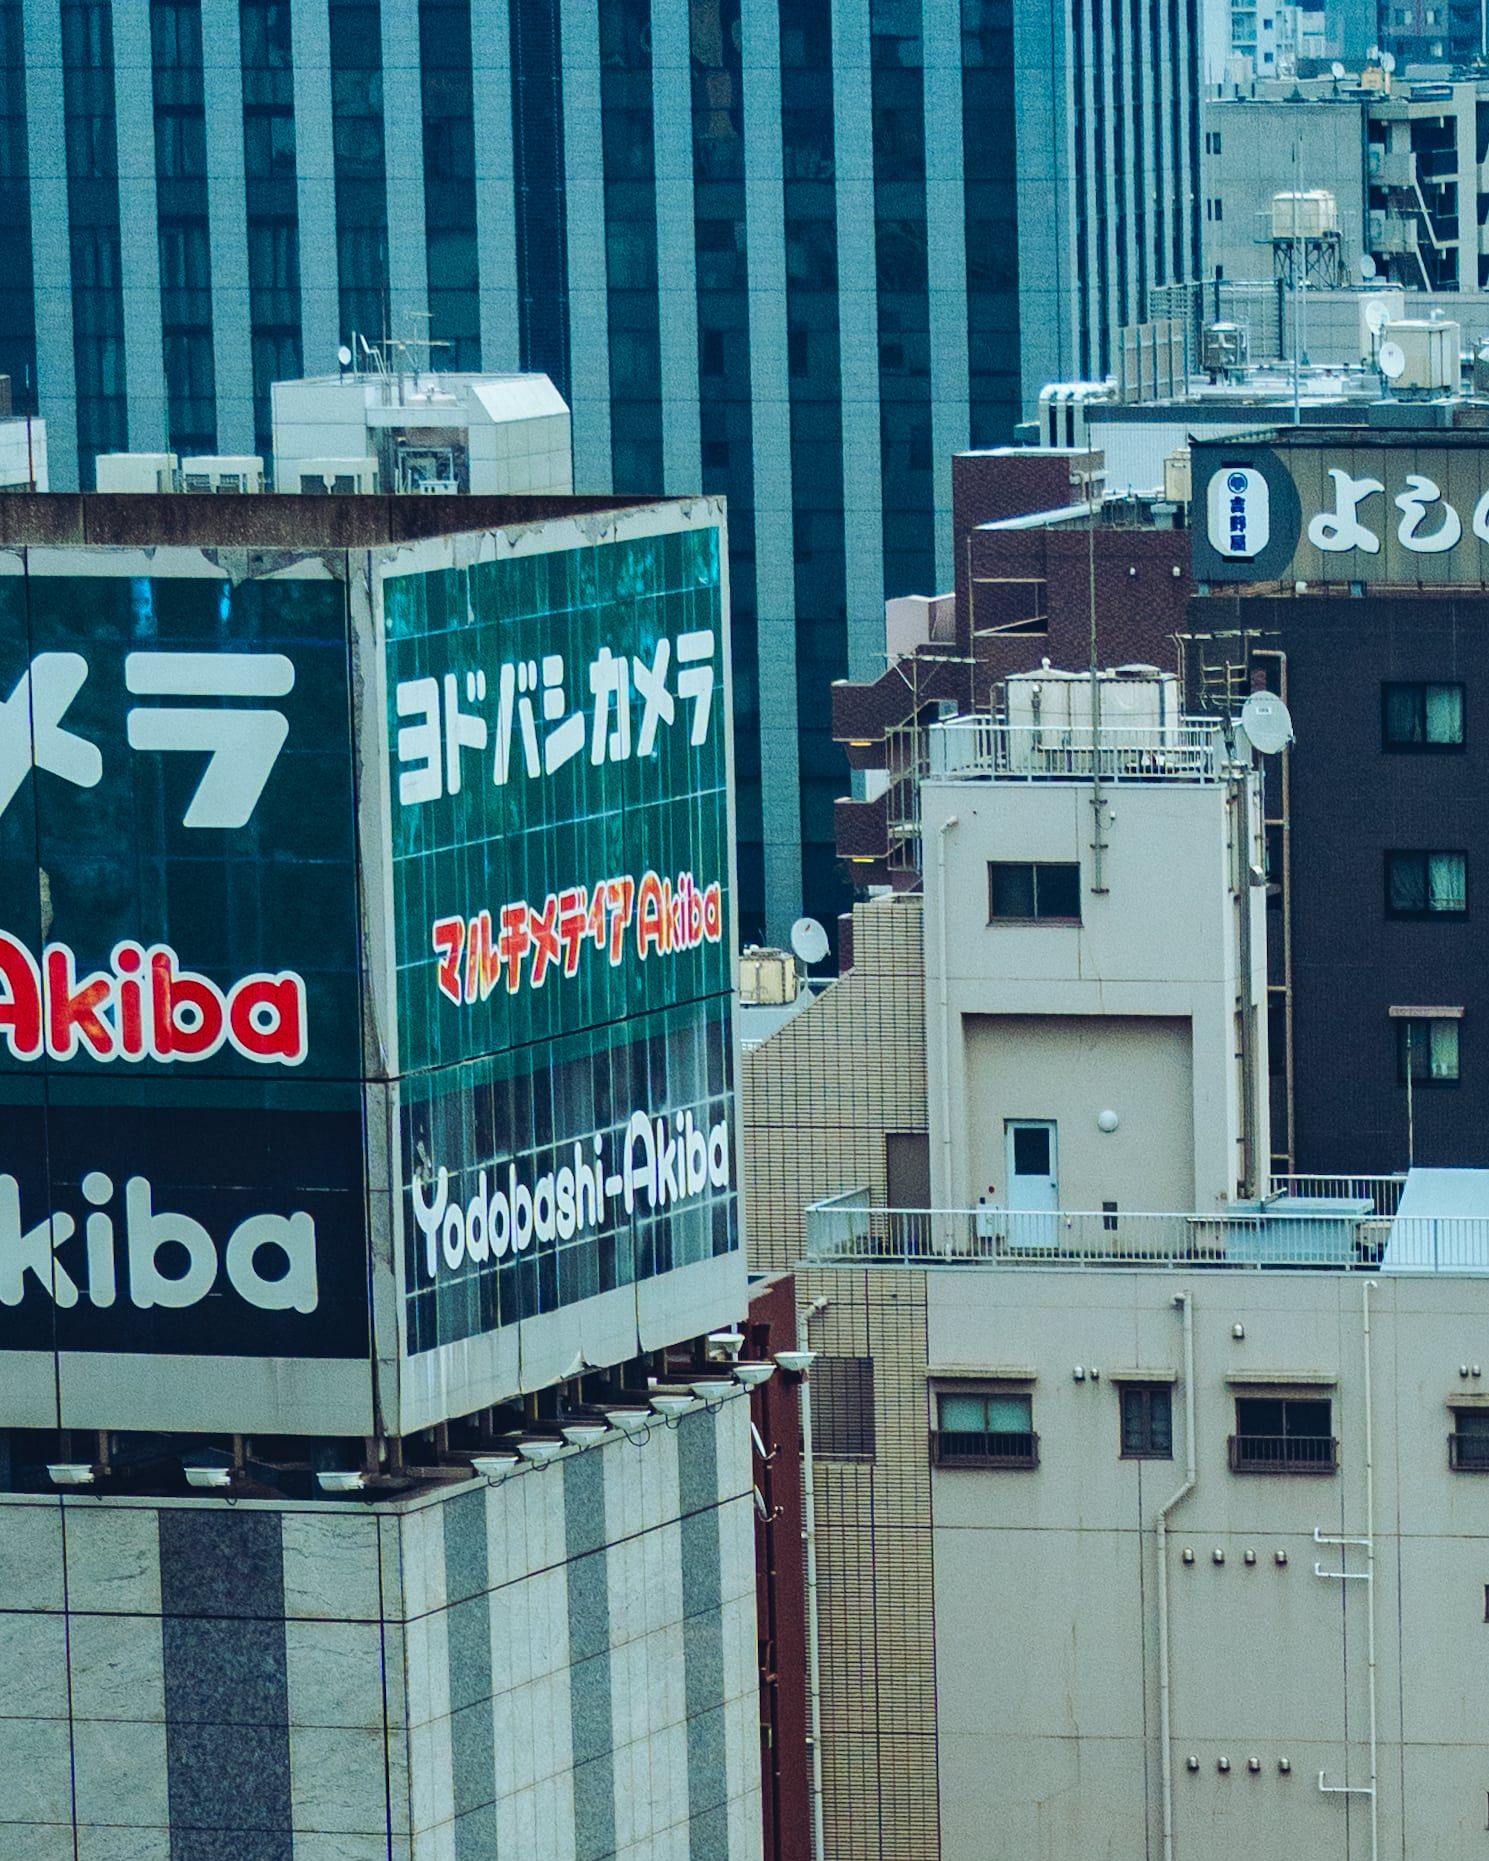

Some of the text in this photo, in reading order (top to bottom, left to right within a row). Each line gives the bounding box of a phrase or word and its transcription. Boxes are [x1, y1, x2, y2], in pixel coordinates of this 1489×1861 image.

[397, 630, 716, 806] ヨドバシカメラ
[431, 869, 723, 1007] マルチメディア Akiba
[412, 1107, 730, 1281] Yodobashi-Akiba
